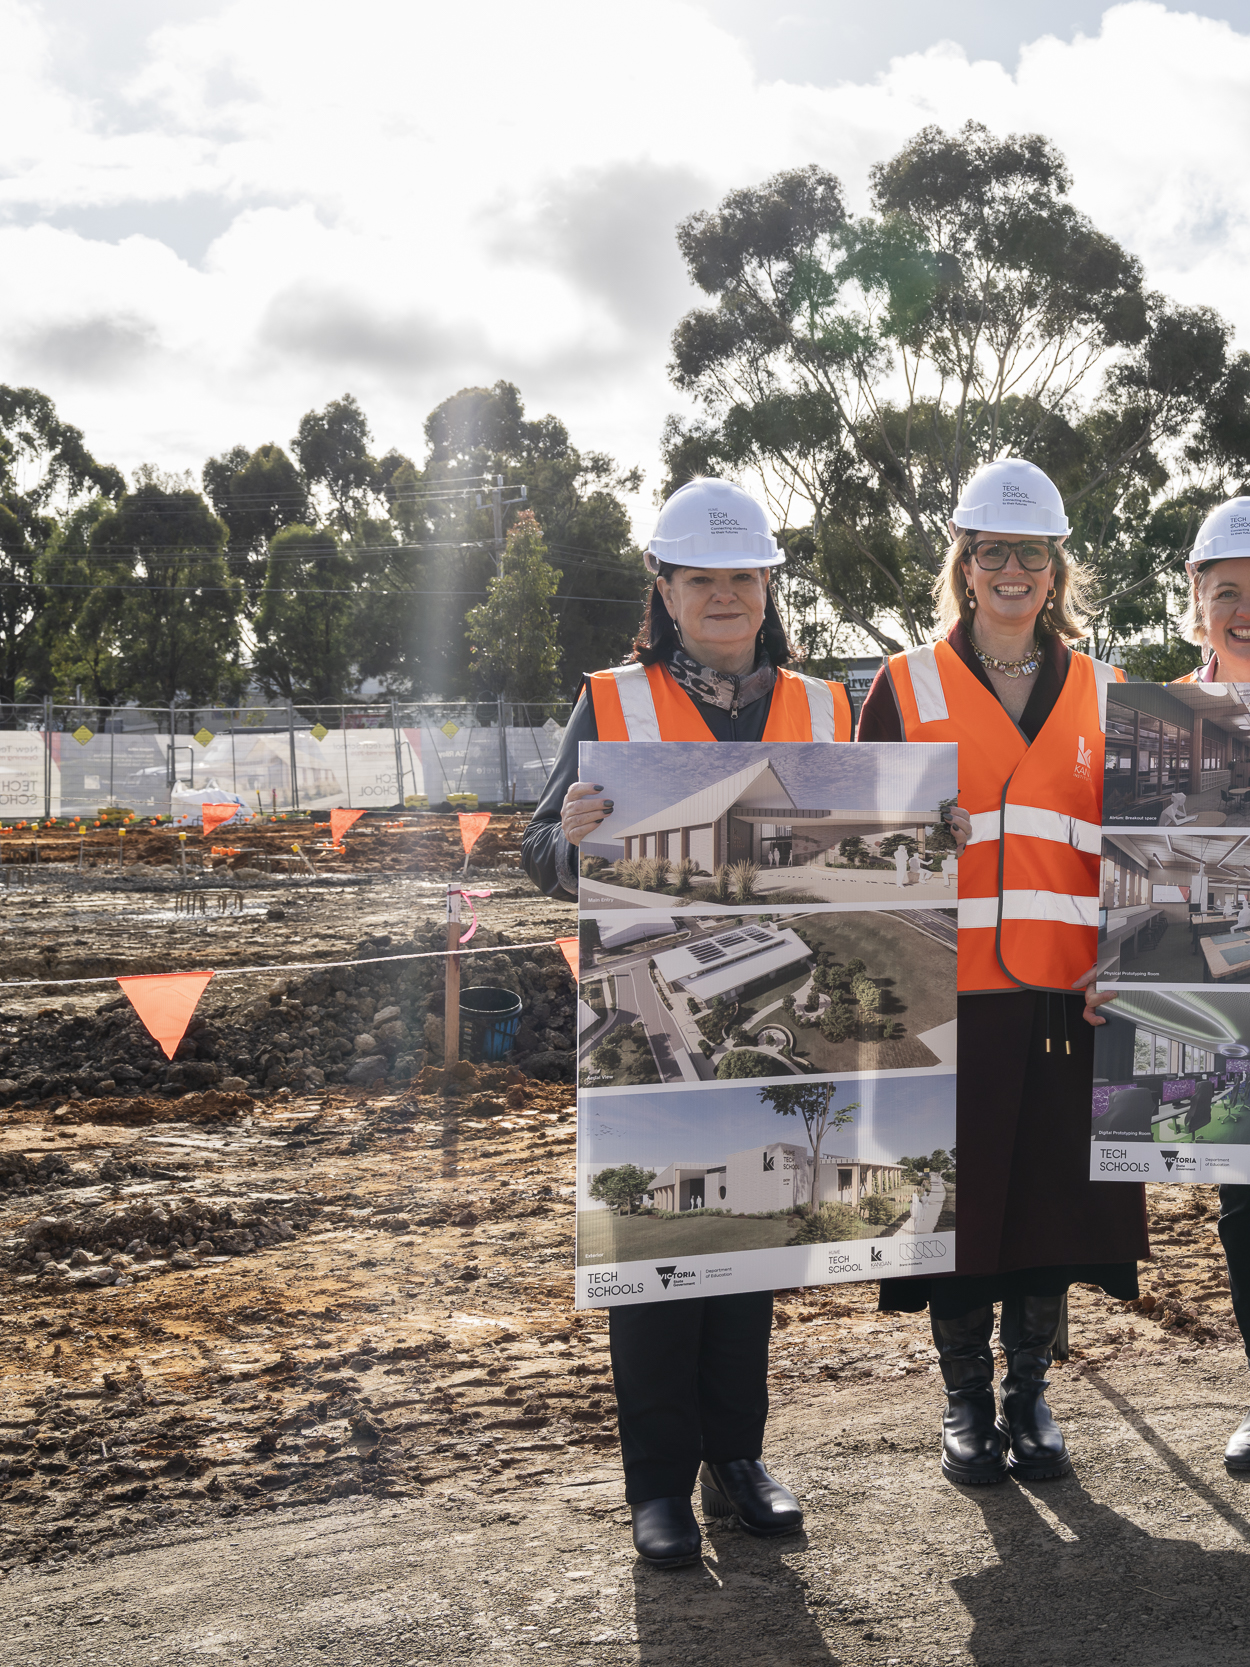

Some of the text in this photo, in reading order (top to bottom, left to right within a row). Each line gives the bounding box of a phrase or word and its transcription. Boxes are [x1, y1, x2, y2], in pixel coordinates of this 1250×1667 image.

[1002, 491, 1030, 499] SCHOOL
[1099, 1148, 1127, 1159] TECH
[1099, 1161, 1150, 1173] SCHOOLS
[828, 1255, 850, 1265] TECH
[828, 1263, 863, 1274] SCHOOL
[587, 1271, 618, 1284] TECH
[659, 1271, 697, 1280] VICTORIA
[587, 1283, 644, 1298] SCHOOLS
